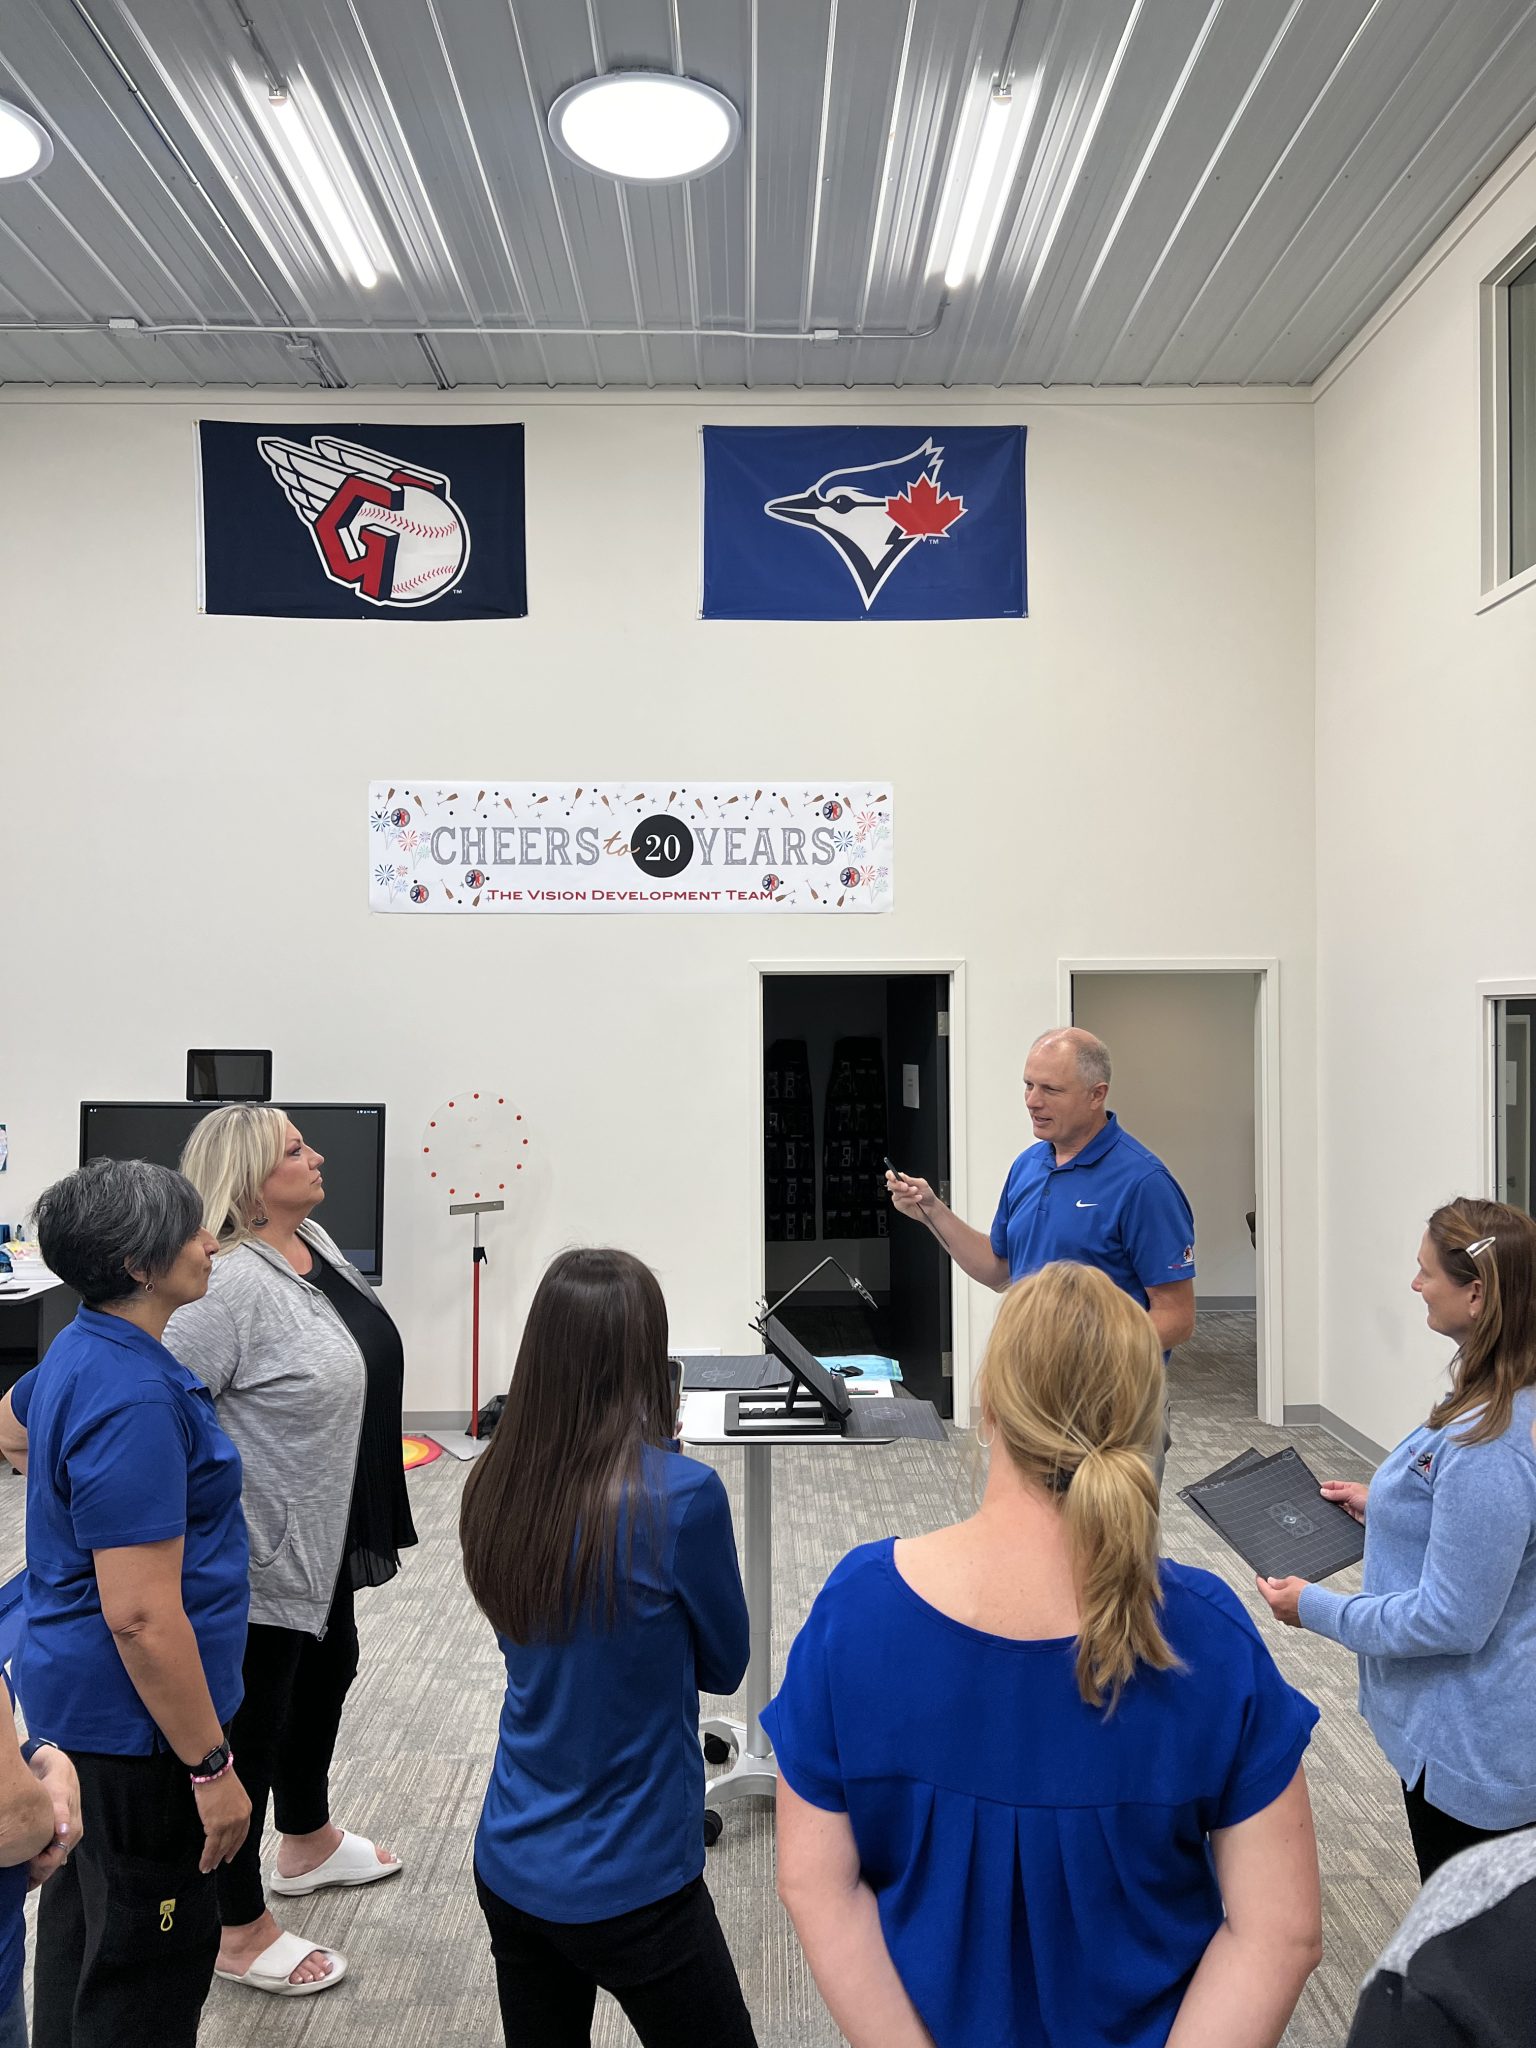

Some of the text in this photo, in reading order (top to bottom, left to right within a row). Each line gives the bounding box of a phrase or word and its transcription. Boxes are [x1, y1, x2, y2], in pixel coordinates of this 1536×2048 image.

[430, 826, 836, 866] CHEERS to 20 YEARS
[487, 889, 774, 901] THE VISION DEVELOPMENT TEAM
